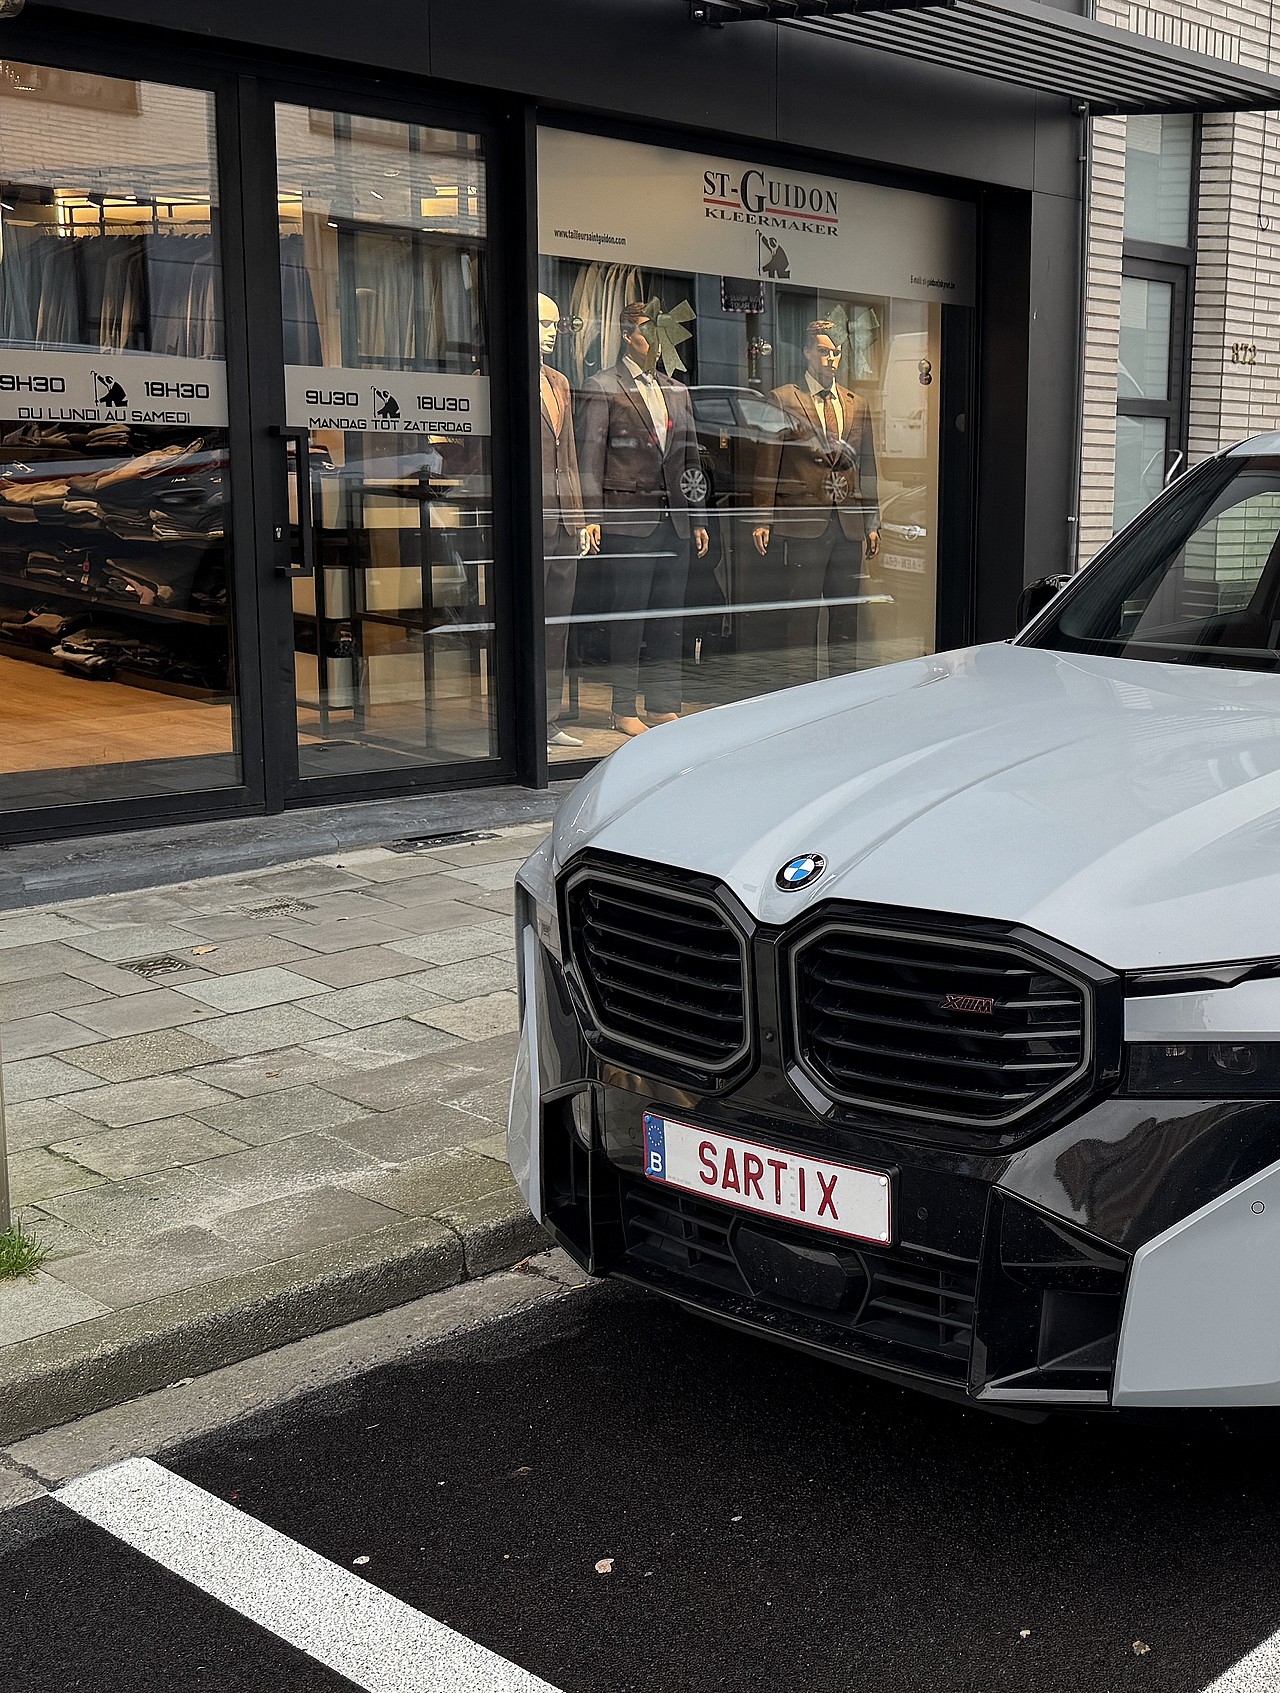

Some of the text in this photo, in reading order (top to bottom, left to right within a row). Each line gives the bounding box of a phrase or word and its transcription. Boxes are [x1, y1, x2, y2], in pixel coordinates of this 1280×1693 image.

[704, 207, 839, 238] KLEERMAKER
[1231, 342, 1257, 366] 872
[0, 374, 210, 399] 9H30 18H30
[305, 390, 470, 412] 9U30 18U30
[18, 407, 190, 424] DU LUNDI AU SAMEDI
[309, 417, 472, 433] MANDAG TOT ZATERDAG
[650, 1151, 663, 1173] B
